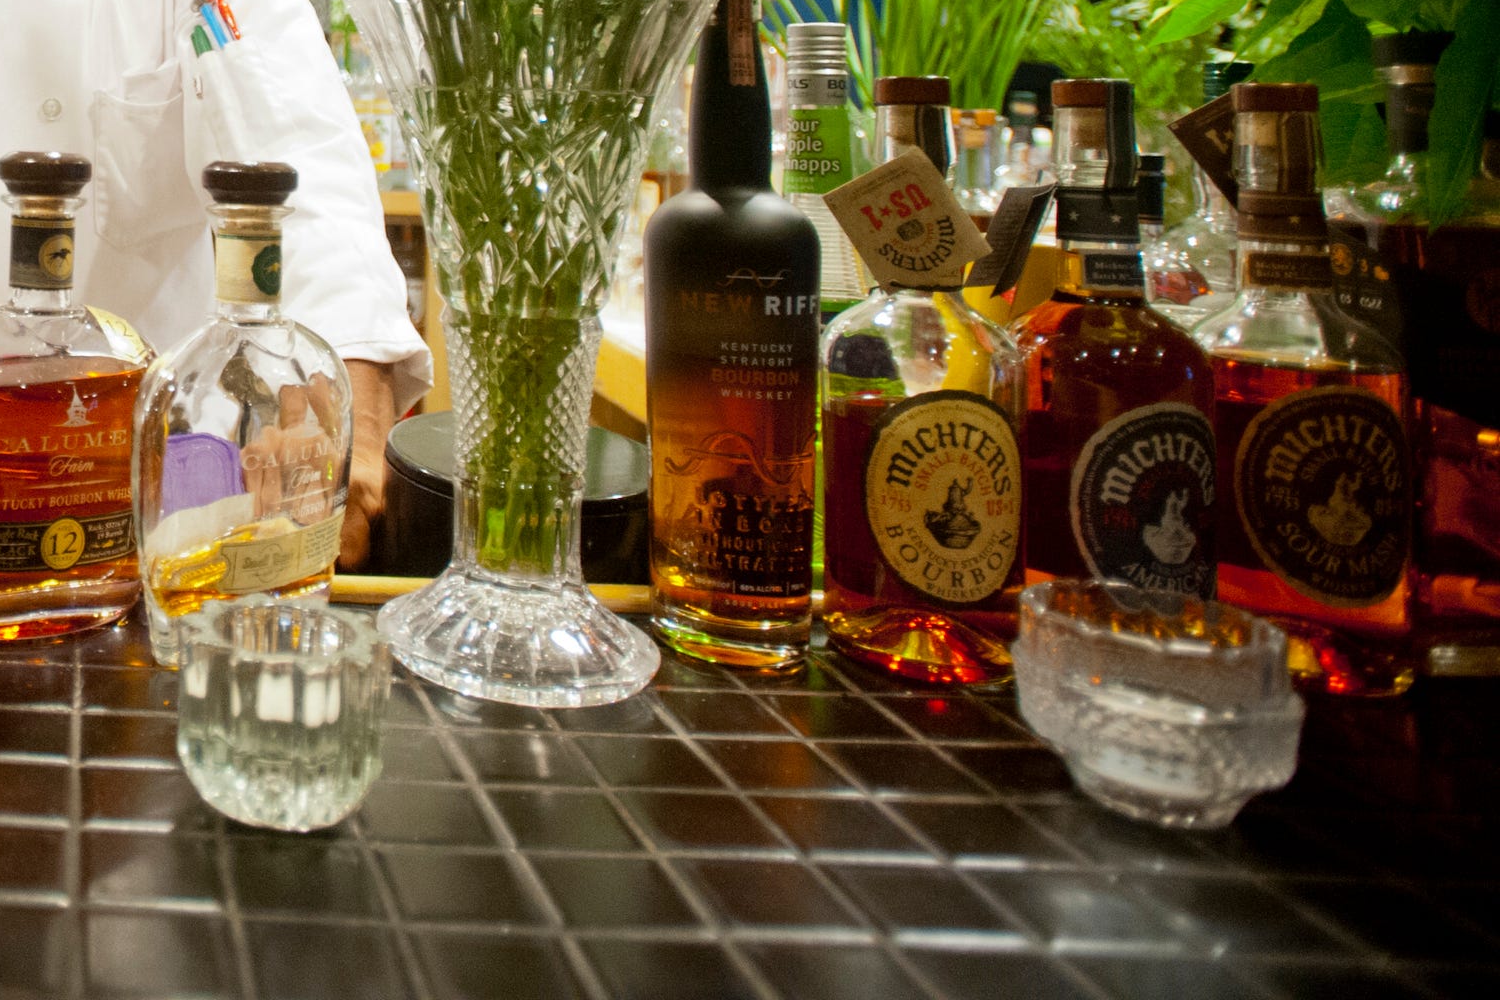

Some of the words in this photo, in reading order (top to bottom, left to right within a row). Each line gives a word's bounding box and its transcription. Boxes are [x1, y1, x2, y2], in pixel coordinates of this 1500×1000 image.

[878, 215, 956, 272] MICHTER'S
[681, 290, 752, 313] NEW
[720, 341, 794, 353] KENTUCKY
[720, 355, 794, 367] STRAIGHT
[711, 368, 799, 386] BOURBON
[721, 388, 793, 400] WHISKEY
[51, 455, 95, 477] Farm
[886, 421, 1011, 497] MICHTER'S
[914, 452, 955, 492] SMALL
[960, 453, 993, 497] BATCH
[50, 492, 103, 507] BOURBON
[49, 532, 78, 556] 12
[1277, 522, 1341, 574] SOUR
[885, 524, 1013, 588] BOURBON
